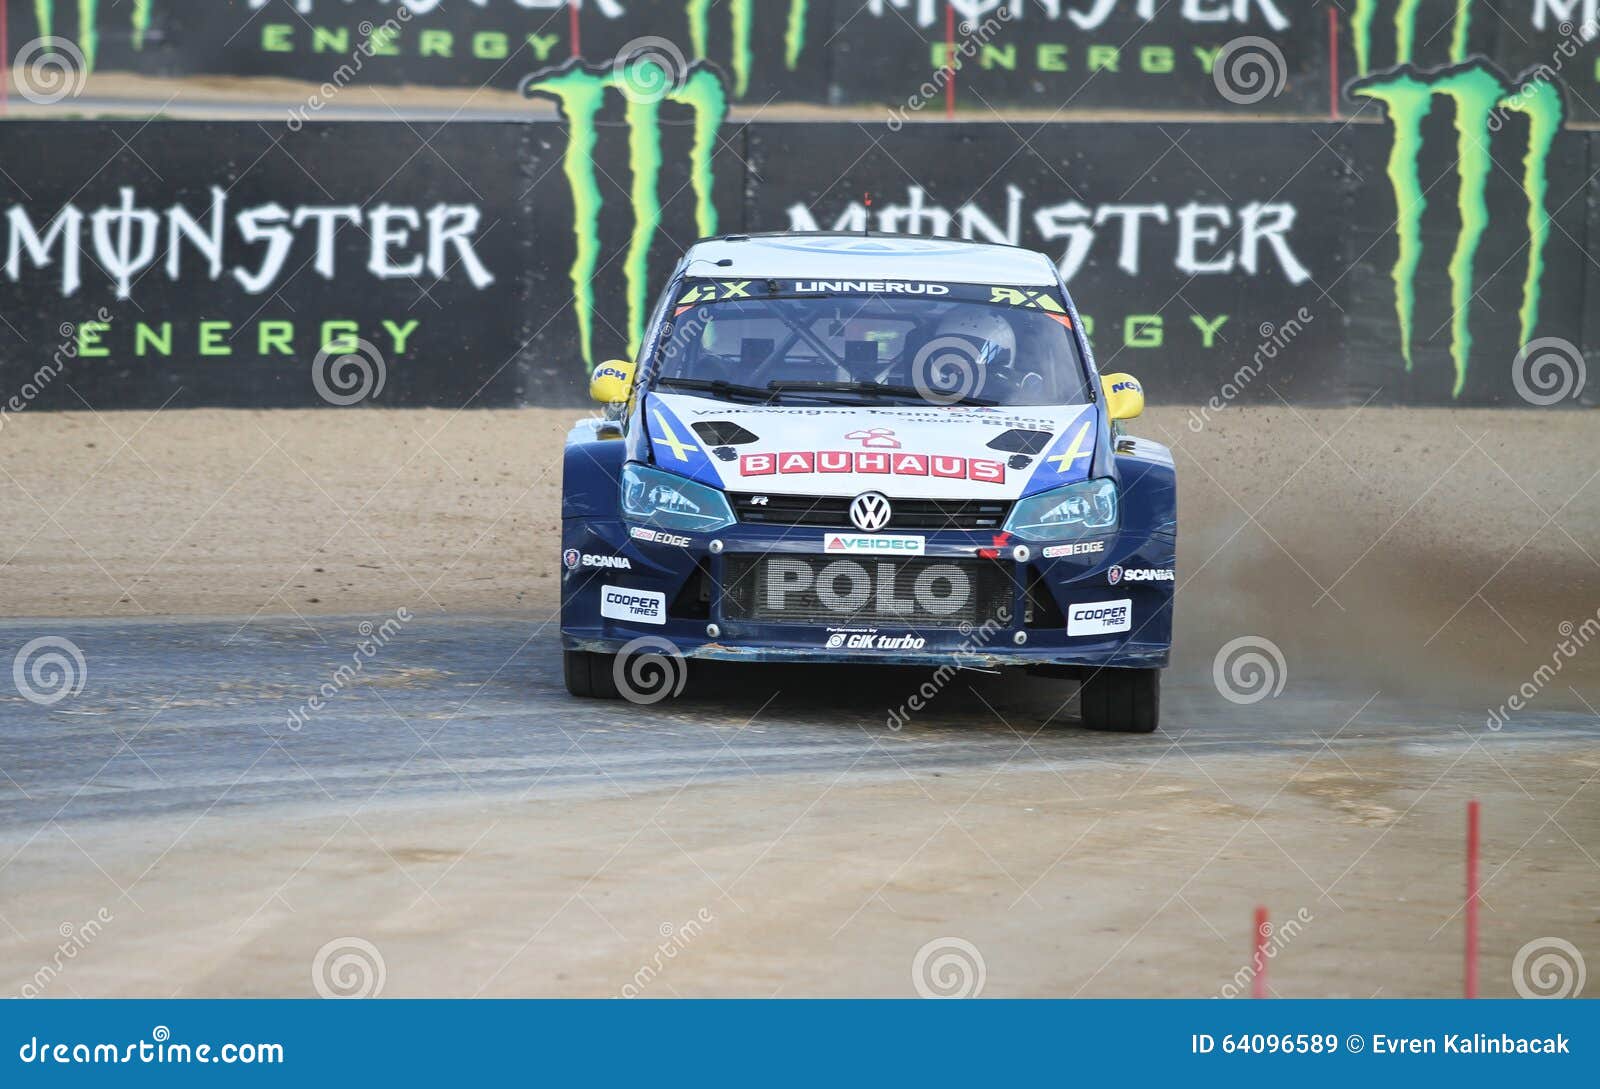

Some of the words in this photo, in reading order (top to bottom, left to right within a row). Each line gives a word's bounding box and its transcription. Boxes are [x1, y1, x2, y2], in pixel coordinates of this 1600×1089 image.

[261, 24, 560, 61] ENERGY
[931, 42, 1226, 75] ENERGY
[3, 185, 496, 301] MONSTER
[795, 281, 950, 295] LINNERUD
[77, 320, 420, 357] ENERGY
[867, 409, 939, 418] Team
[950, 412, 1056, 424] Sweden
[982, 418, 1056, 432] BRIS
[744, 453, 1000, 479] BAUHAUS
[654, 532, 692, 548] EDGE
[842, 536, 919, 550] VEIDEC
[1074, 540, 1105, 555] EDGE
[582, 553, 632, 569] SCANIA
[1123, 568, 1175, 581] SCANIA
[766, 559, 972, 615] POLO
[606, 592, 660, 609] COOPER
[629, 606, 659, 617] TIRES
[1074, 606, 1127, 621] COOPER
[1101, 617, 1125, 627] TIRES
[877, 633, 926, 649] turbo
